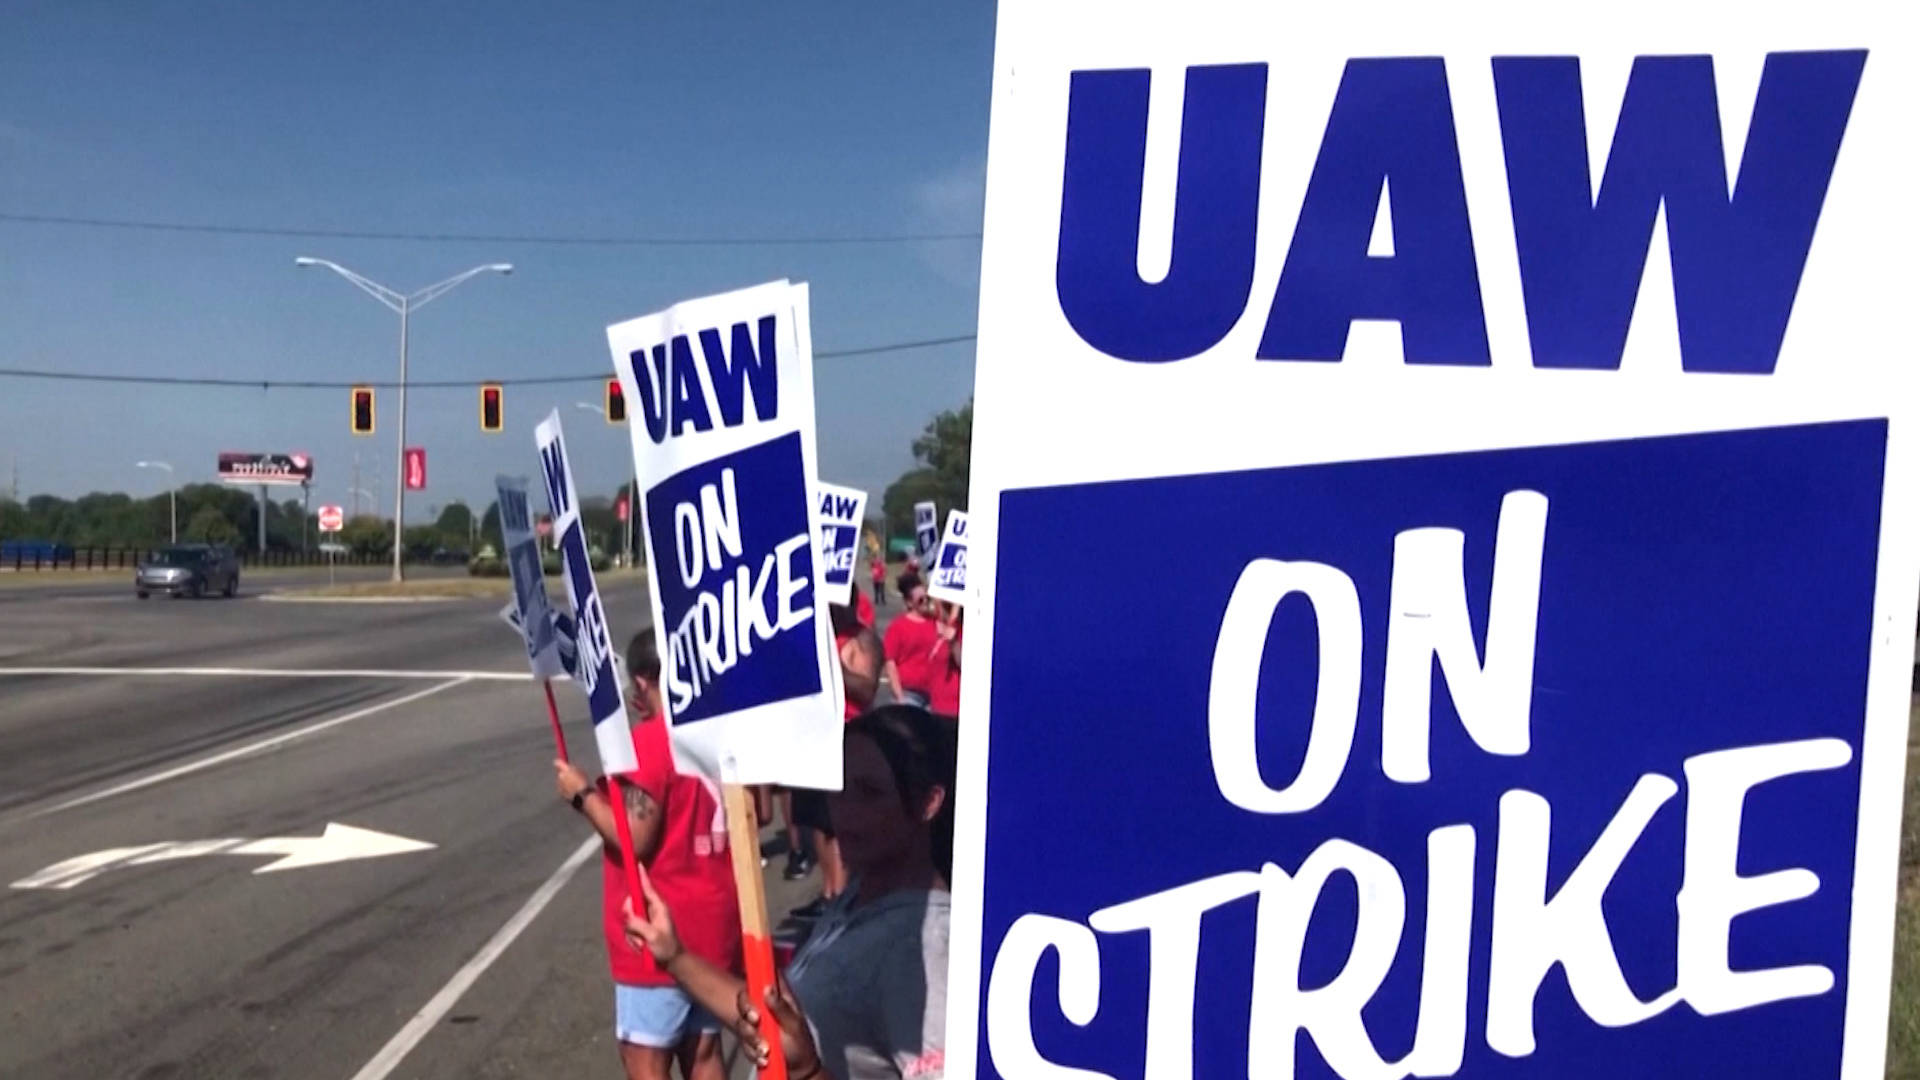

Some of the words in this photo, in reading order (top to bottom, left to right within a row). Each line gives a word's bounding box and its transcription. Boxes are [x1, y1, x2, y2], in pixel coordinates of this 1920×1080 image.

[1056, 49, 1868, 374] UAW
[630, 315, 777, 444] UAW
[675, 468, 743, 588] ON
[820, 493, 858, 521] AW
[667, 534, 814, 714] STRIKE
[1209, 490, 1548, 814] ON
[988, 738, 1852, 1080] STRIKE
